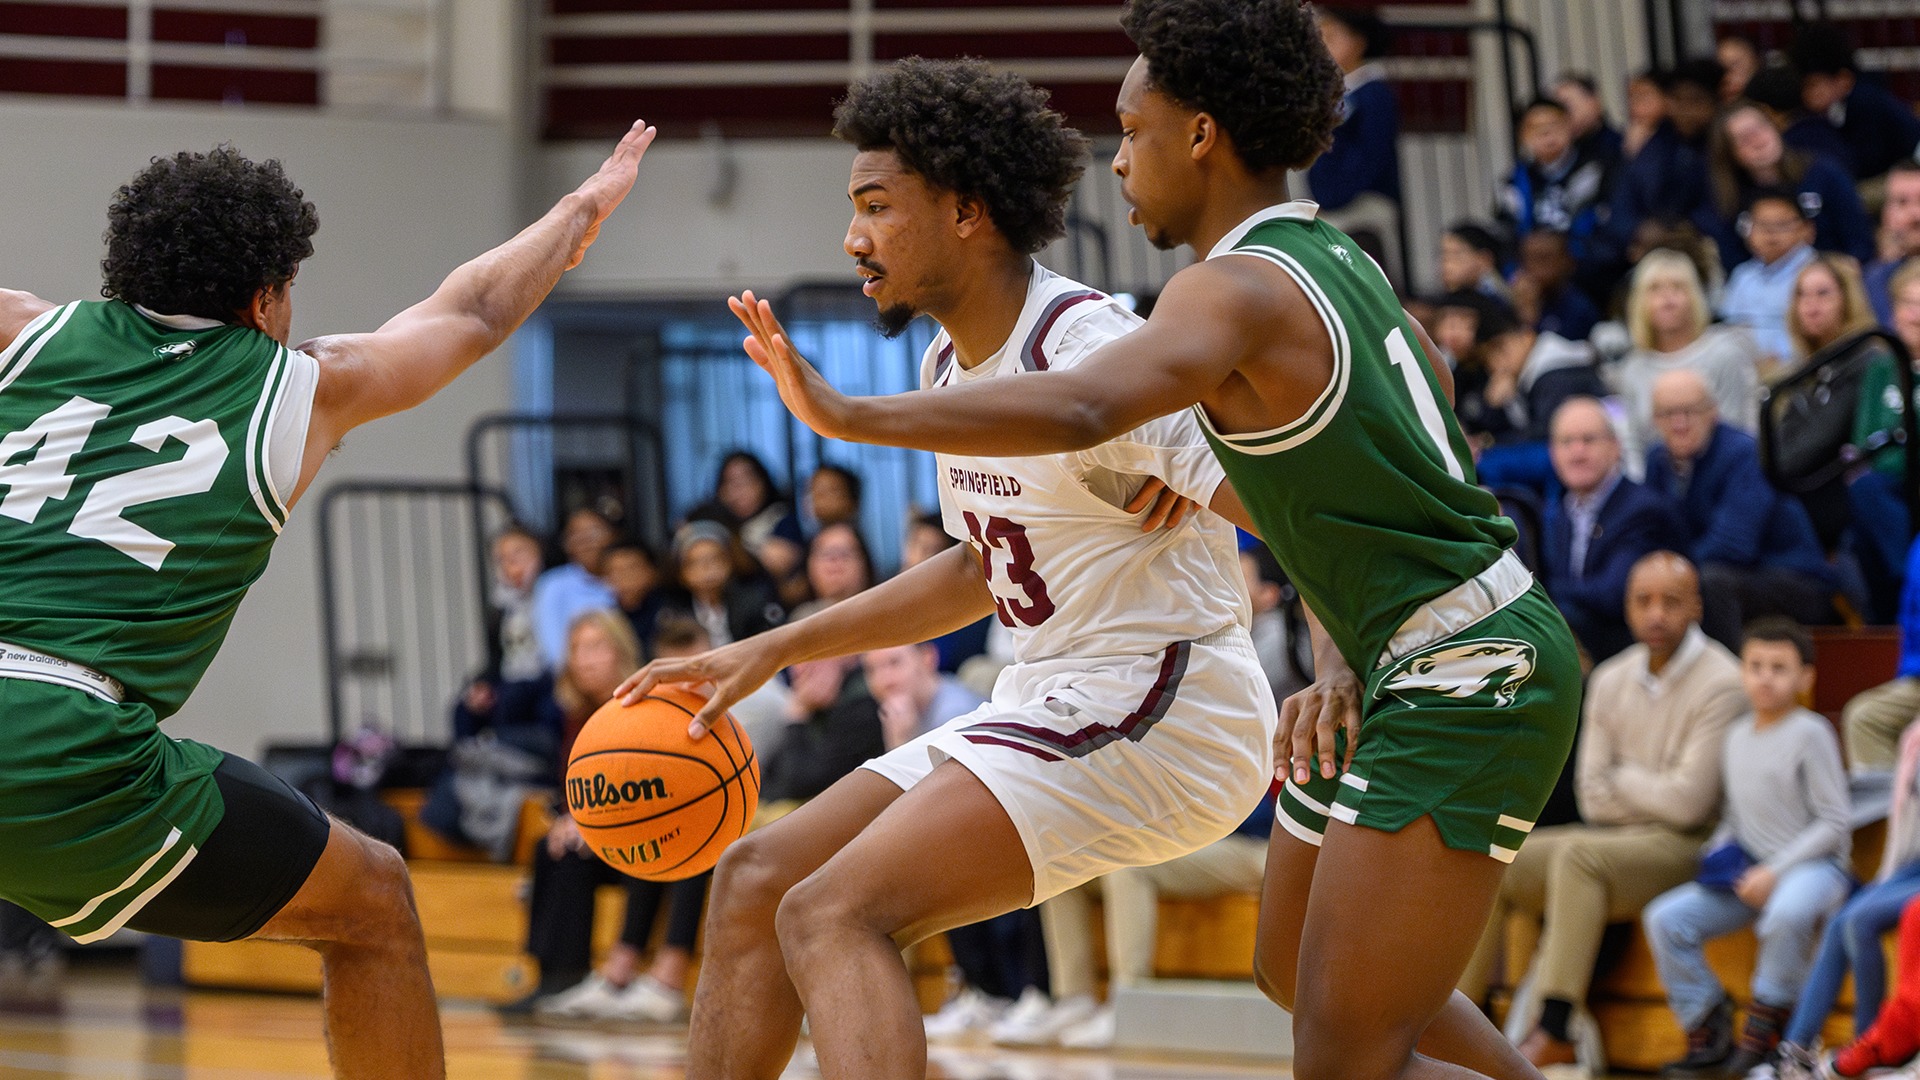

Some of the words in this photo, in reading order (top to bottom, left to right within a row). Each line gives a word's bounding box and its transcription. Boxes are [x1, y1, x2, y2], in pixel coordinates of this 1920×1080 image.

[0, 395, 230, 572] 42
[949, 466, 1022, 497] SPRINGFIELD
[7, 651, 28, 661] new
[29, 653, 69, 668] balance
[567, 772, 668, 811] Wilson
